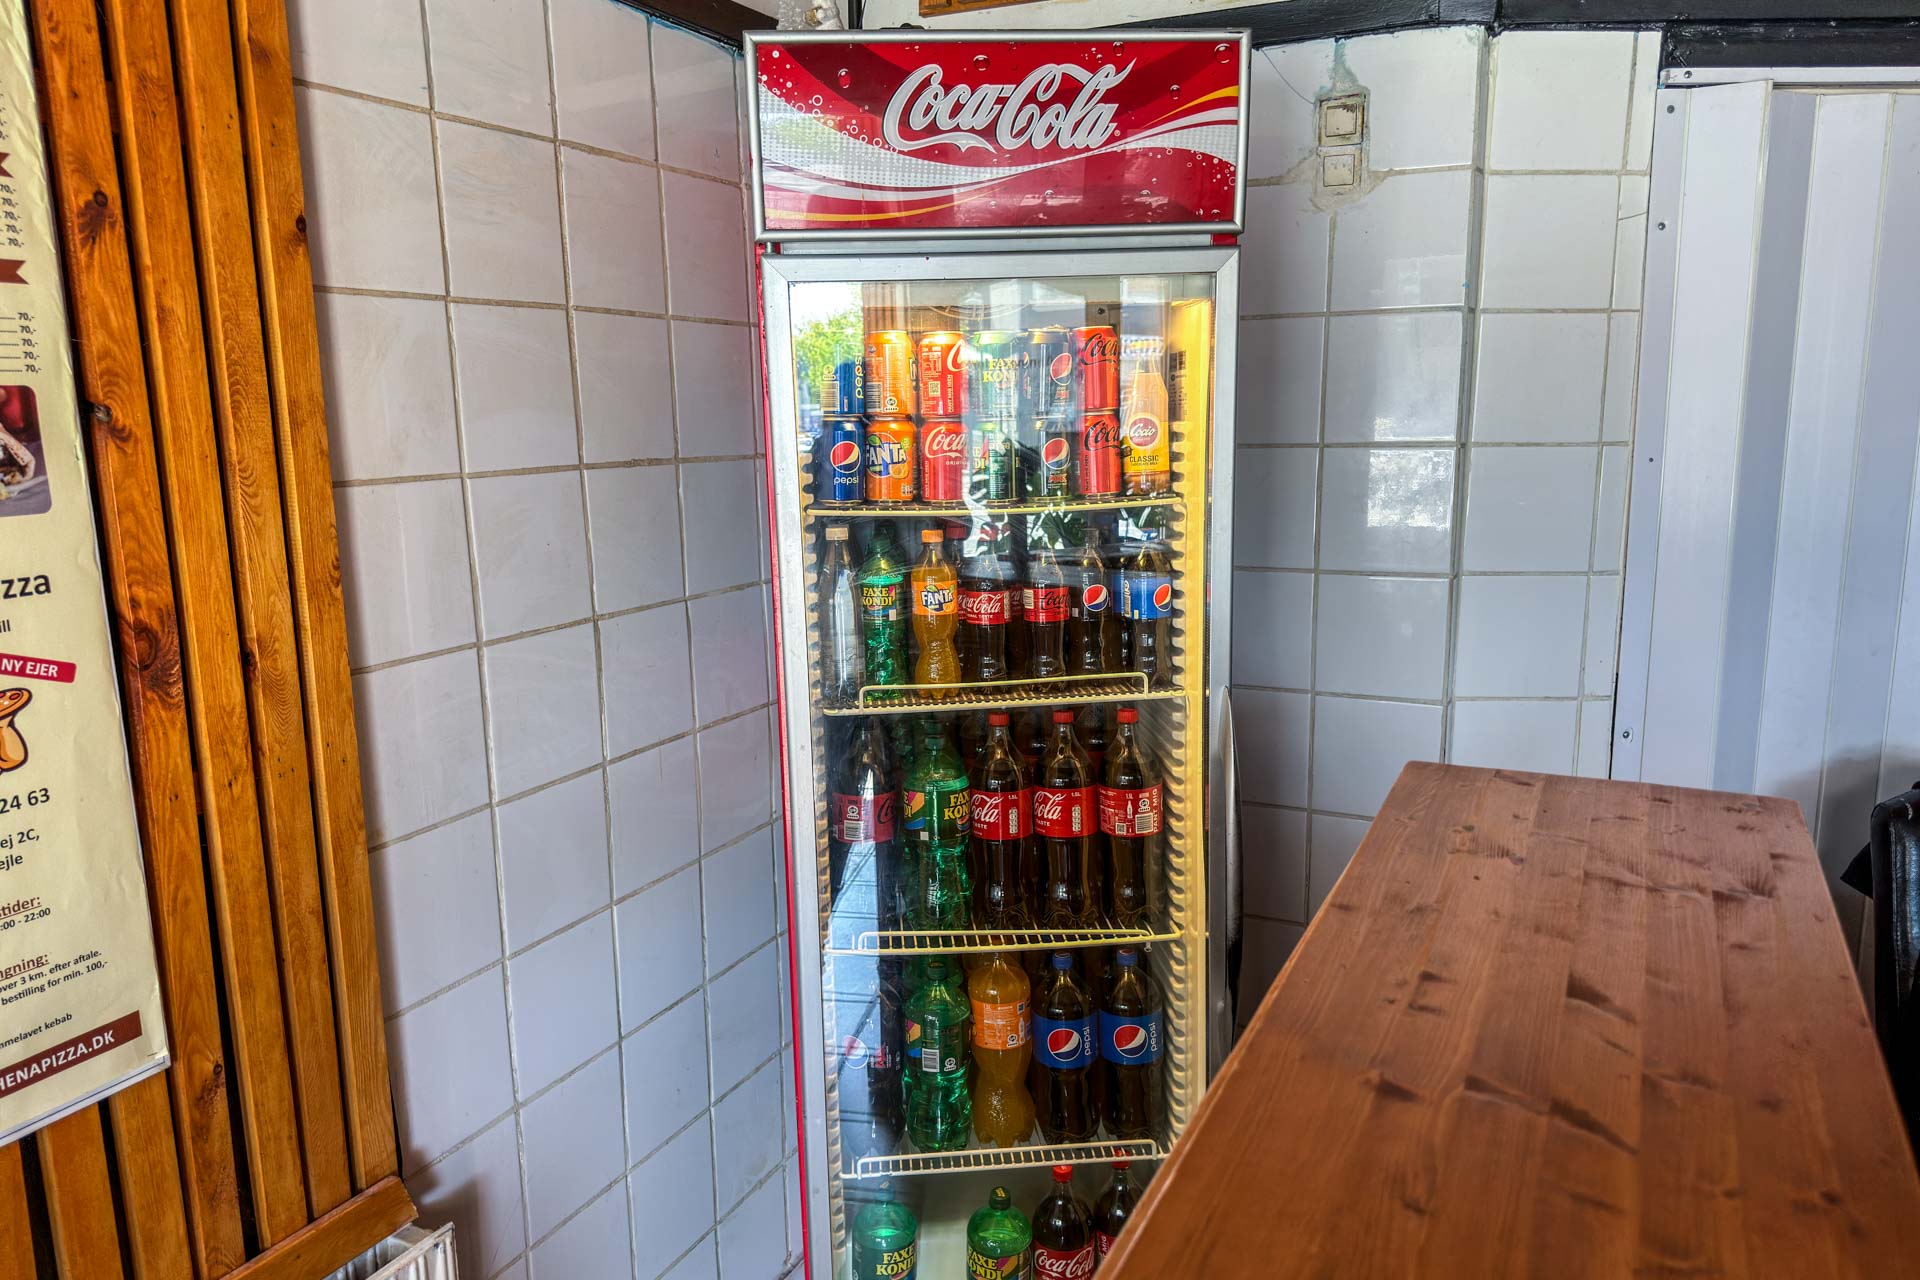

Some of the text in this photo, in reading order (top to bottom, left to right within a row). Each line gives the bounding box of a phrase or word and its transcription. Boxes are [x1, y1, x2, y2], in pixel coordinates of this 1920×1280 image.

[882, 57, 1137, 154] Coca-Cola
[17, 312, 35, 322] 70,-
[19, 325, 37, 335] 70,-
[21, 338, 38, 348] 70,-
[23, 351, 40, 361] 70,-
[24, 364, 42, 374] 70,-
[1129, 455, 1159, 463] CLASSIC
[1, 574, 51, 599] zza
[863, 587, 889, 597] FAXE
[921, 589, 953, 606] FANTA
[1, 658, 58, 678] NY EJER
[0, 787, 50, 814] 24 63
[17, 828, 40, 844] 2C,
[0, 896, 41, 917] tider:
[24, 907, 51, 923] 22:00
[20, 976, 27, 986] 3
[29, 972, 47, 983] km.
[49, 962, 71, 974] efter
[73, 950, 102, 966] aftale.
[1, 960, 108, 1006] bestilling for min. 100,-
[44, 1012, 73, 1031] kebab
[1082, 1026, 1091, 1056] pepsi
[1148, 1022, 1158, 1052] pepsi
